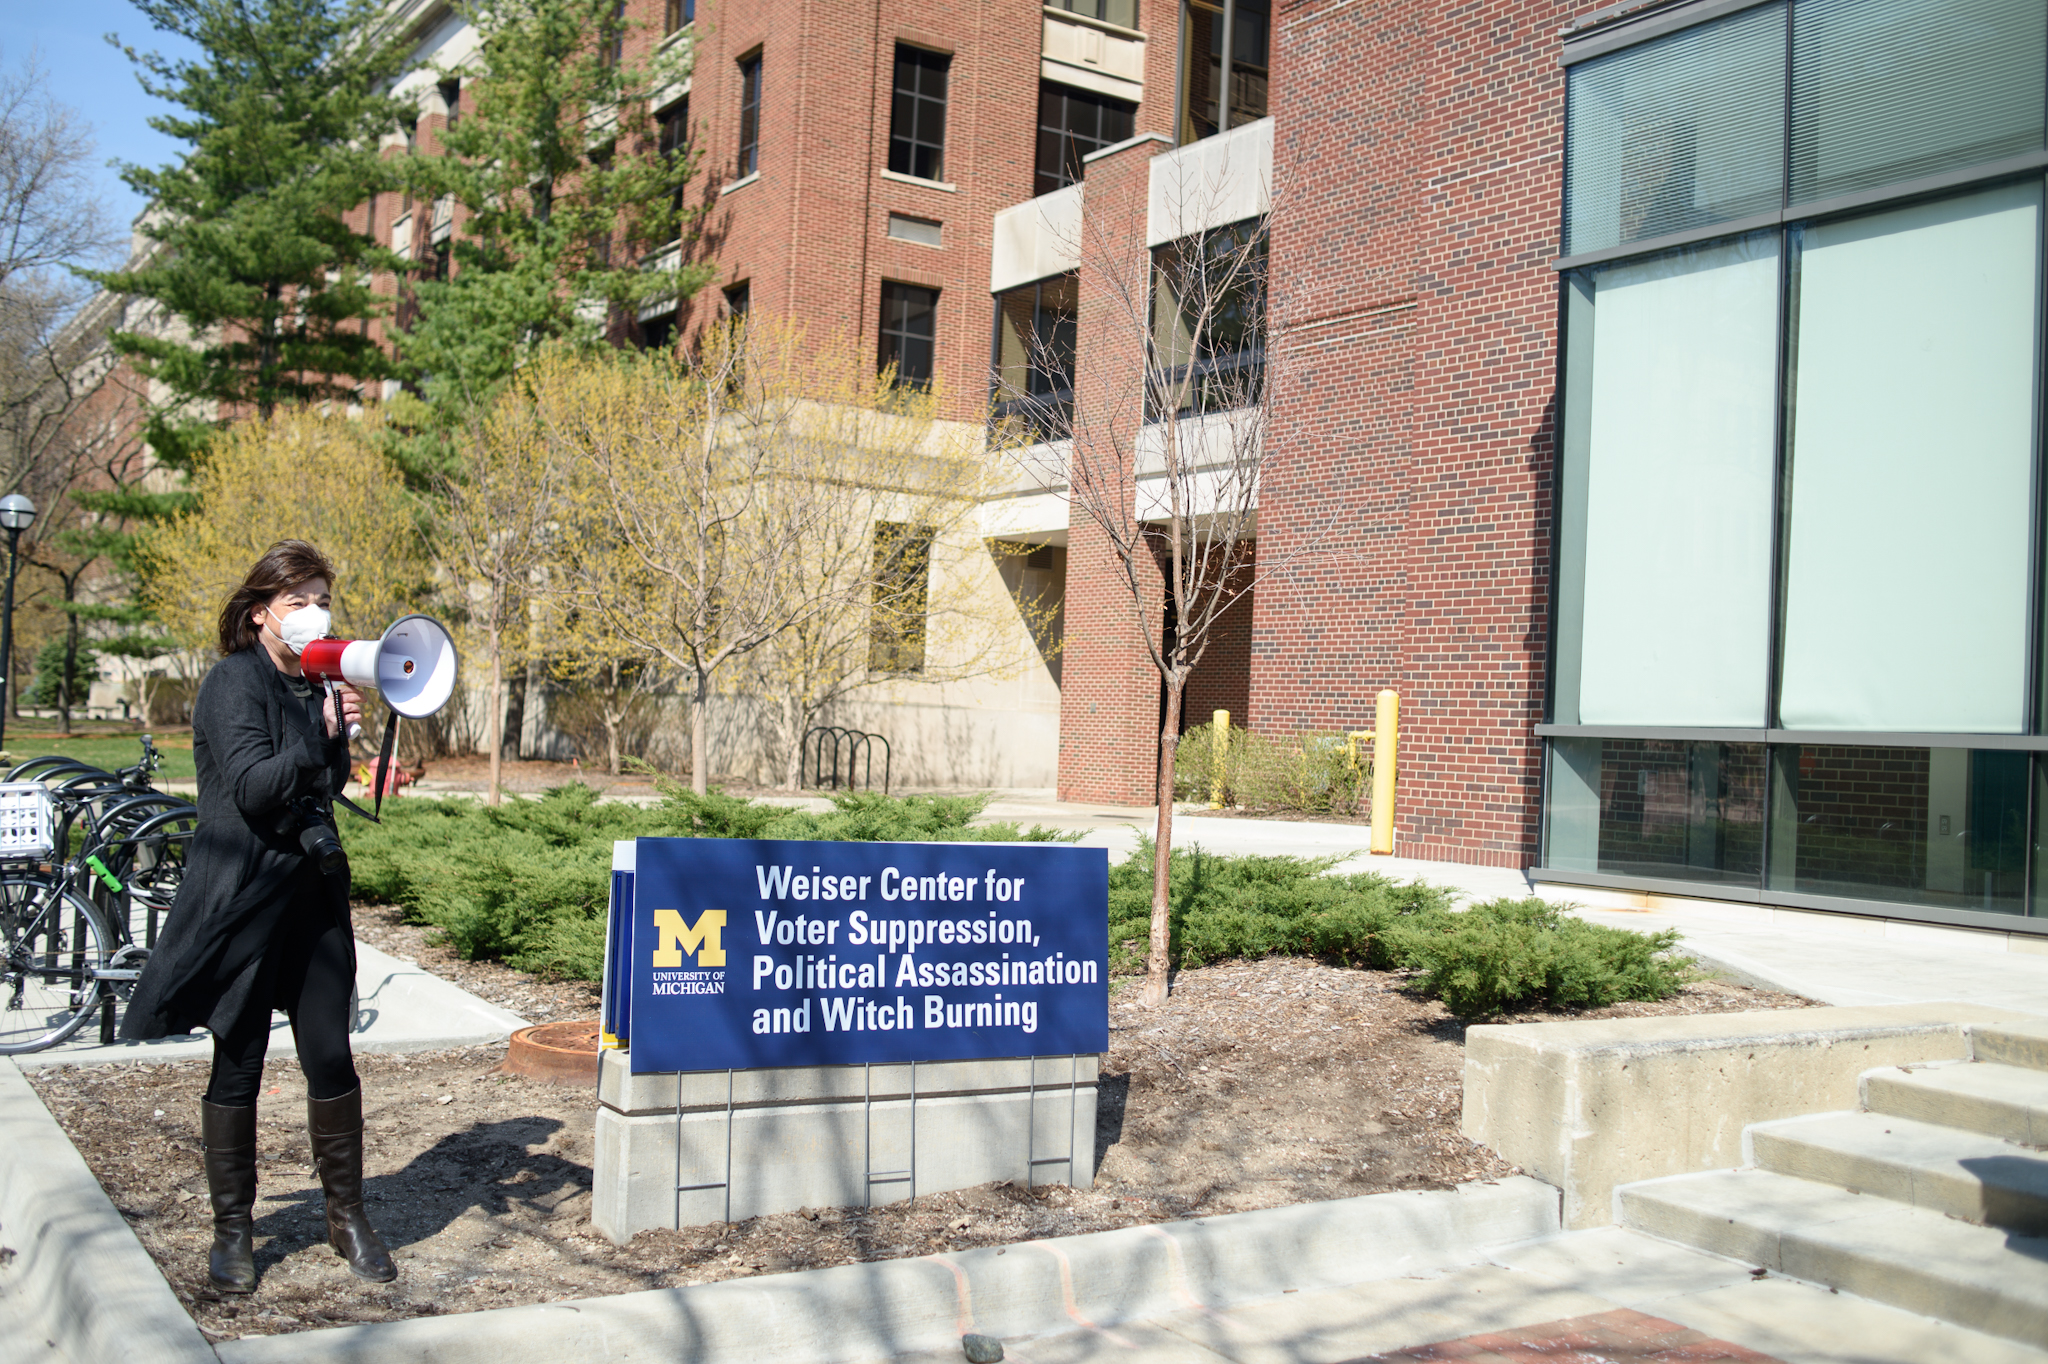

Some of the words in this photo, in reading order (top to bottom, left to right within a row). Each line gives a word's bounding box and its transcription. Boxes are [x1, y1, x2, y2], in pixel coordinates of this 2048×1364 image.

[755, 865, 872, 901] Weiser
[880, 866, 979, 902] Center
[984, 868, 1025, 902] for
[652, 909, 727, 968] M
[754, 910, 840, 946] Voter
[847, 909, 1041, 954] Suppression,
[652, 971, 712, 982] UNIVERSITY
[712, 971, 726, 981] OF
[652, 981, 726, 996] MICHIGAN
[753, 953, 886, 991] Political
[894, 951, 1098, 988] Assassination
[752, 997, 811, 1035] and
[819, 995, 914, 1032] Witch
[924, 993, 1038, 1034] Burning
